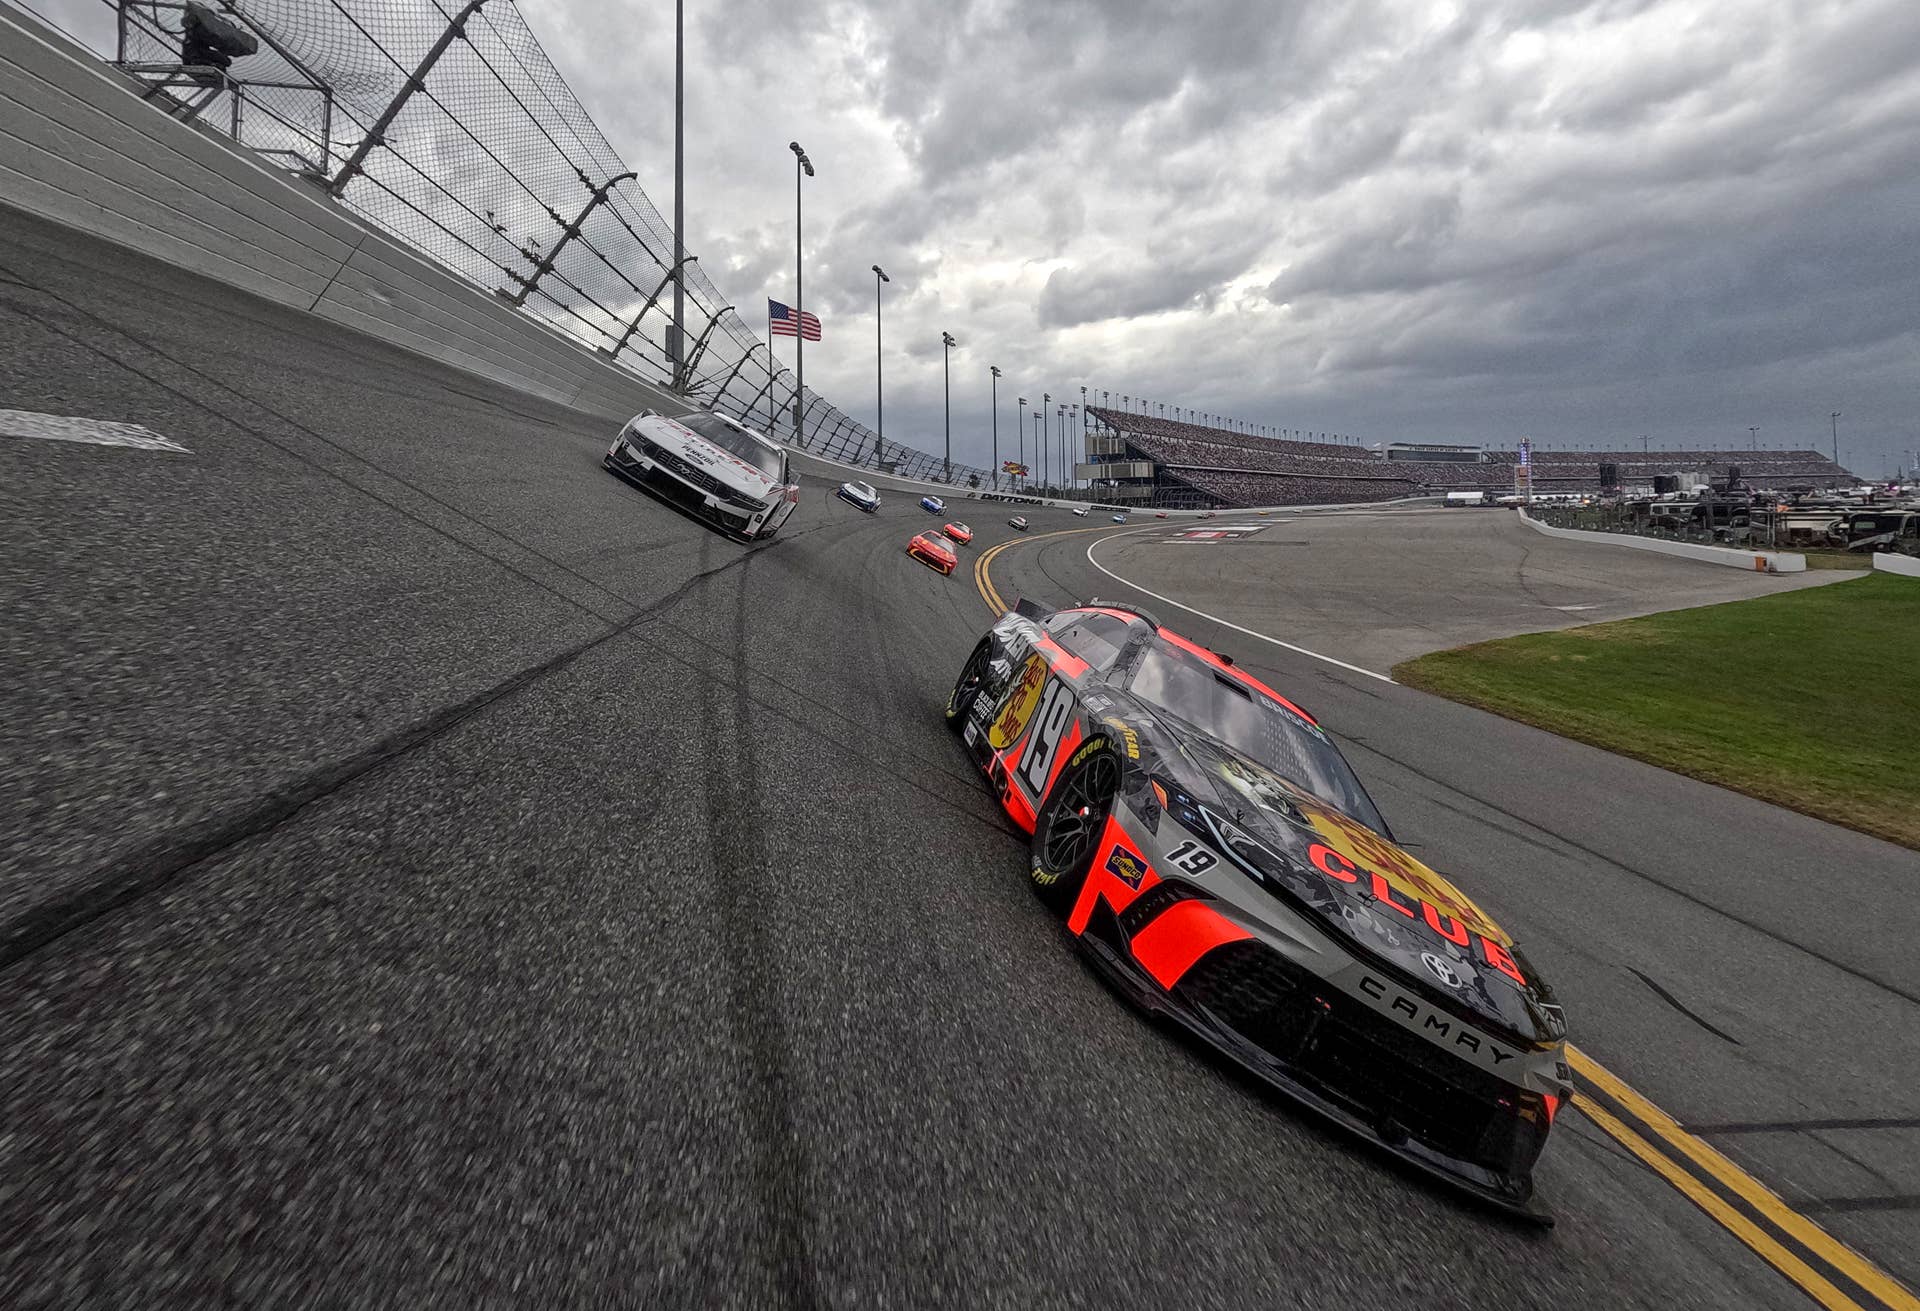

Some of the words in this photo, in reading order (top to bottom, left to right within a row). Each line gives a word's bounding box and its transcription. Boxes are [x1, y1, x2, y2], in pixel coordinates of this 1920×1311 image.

[681, 444, 715, 466] PENNZOIL
[980, 493, 1043, 506] DAYTONA
[1019, 677, 1075, 795] 19
[1259, 694, 1331, 746] BRISCOE
[1111, 855, 1143, 881] SUNOCO
[1165, 841, 1218, 876] 19
[1308, 843, 1526, 986] CLUB
[1359, 975, 1515, 1064] CAMRY
